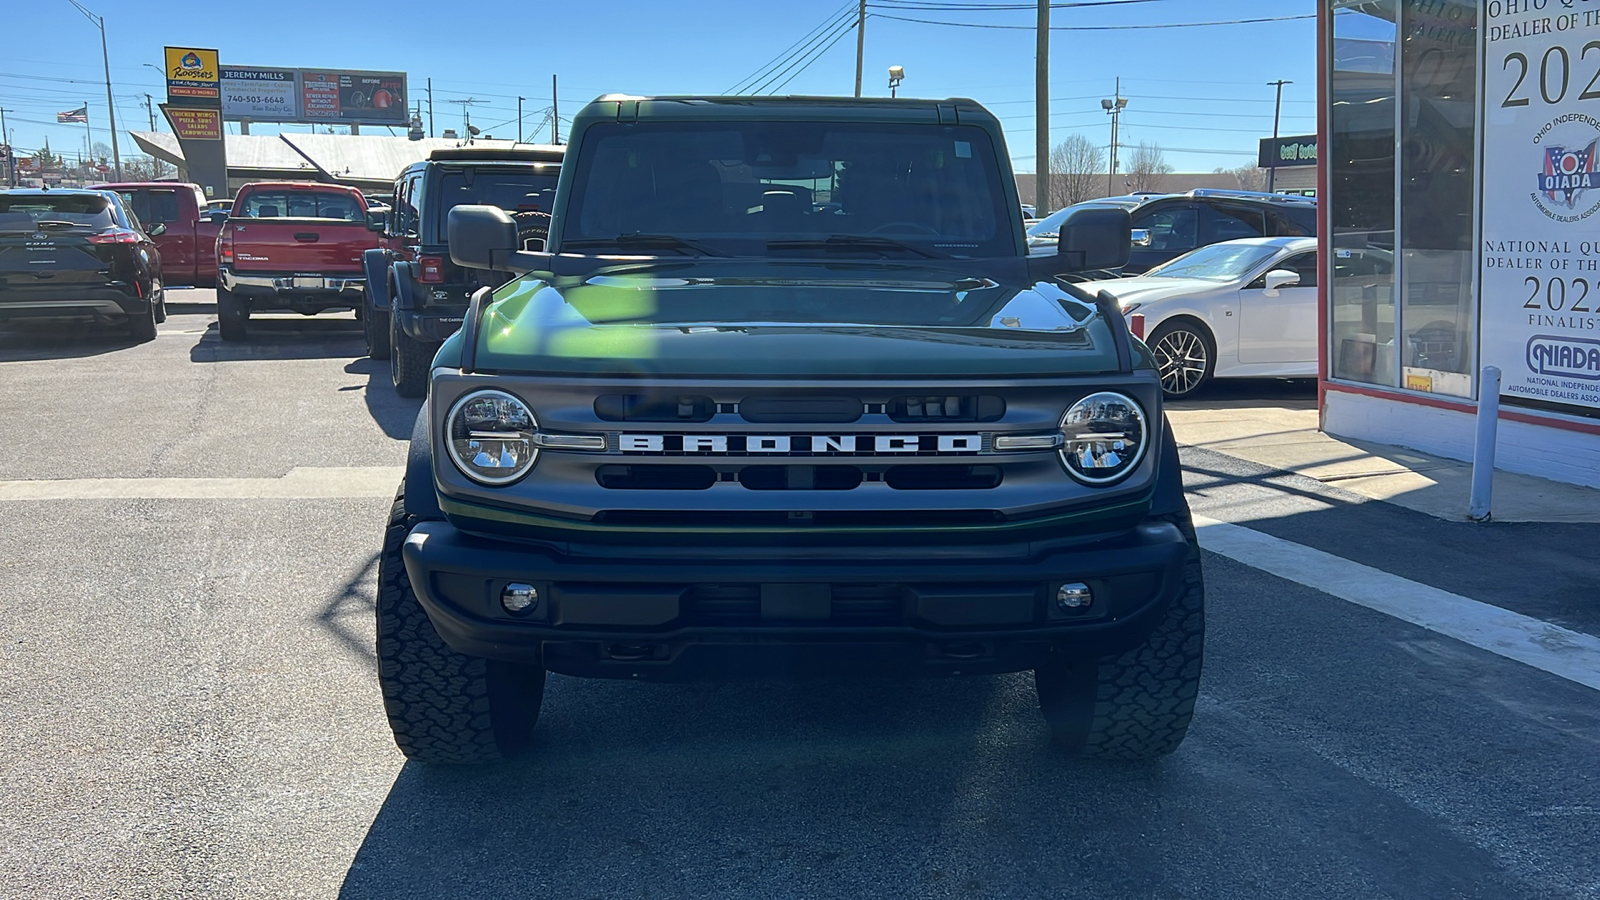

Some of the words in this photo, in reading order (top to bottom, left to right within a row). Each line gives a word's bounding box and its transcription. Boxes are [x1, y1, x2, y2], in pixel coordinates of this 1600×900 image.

[1490, 17, 1552, 42] DEALER
[1556, 13, 1578, 31] OF
[172, 66, 213, 79] Roosters
[227, 95, 285, 104] 740-503-6648
[1533, 123, 1552, 144] OHIO
[1545, 173, 1591, 189] OIADA
[1530, 193, 1555, 220] AUTOMOBILE
[1556, 214, 1580, 222] DEALERS
[1485, 240, 1571, 253] NATIONAL
[1487, 257, 1542, 269] DEALER
[1550, 258, 1569, 270] OF
[1533, 343, 1600, 371] NIADA
[1526, 376, 1559, 387] NATIONAL
[1508, 384, 1548, 396] AUTOMOBILE
[1550, 389, 1579, 400] DEALERS
[618, 433, 982, 453] BRONCO
